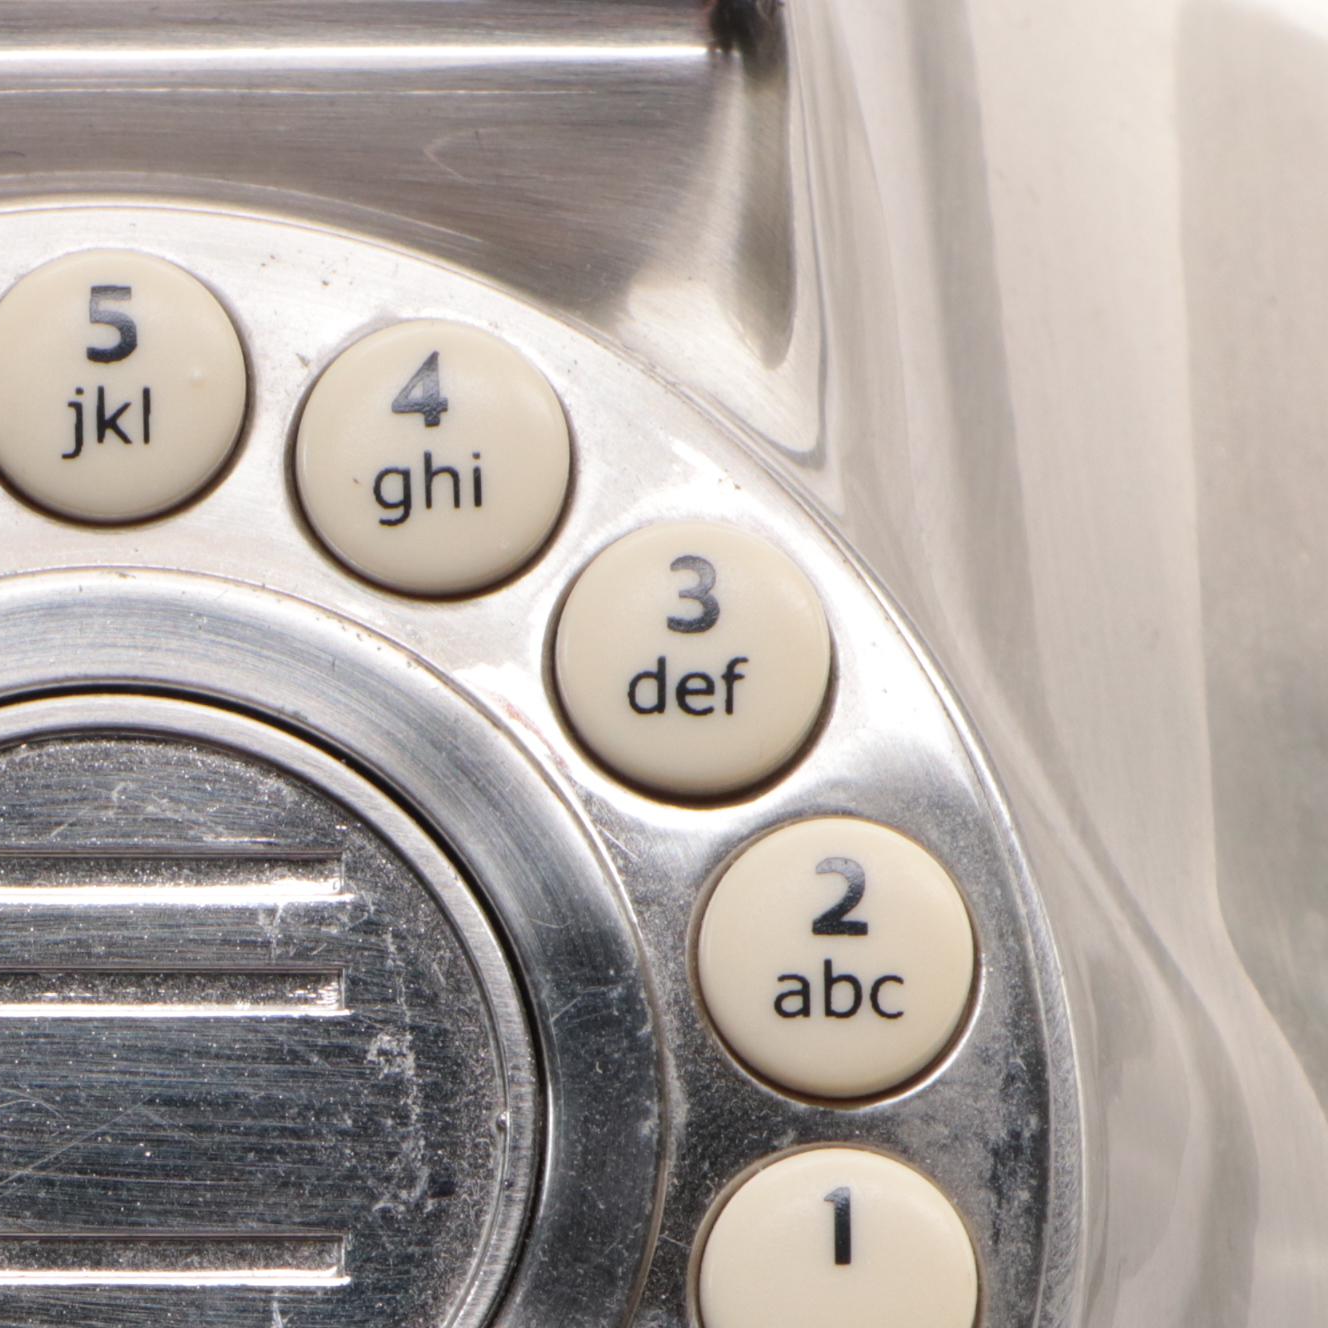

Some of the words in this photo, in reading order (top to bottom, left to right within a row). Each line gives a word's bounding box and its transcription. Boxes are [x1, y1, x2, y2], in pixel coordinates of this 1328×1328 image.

[85, 283, 138, 365] 5
[61, 385, 151, 460] jkl
[390, 350, 448, 428] 4
[373, 450, 482, 527] ghi
[666, 554, 720, 634] 3
[627, 655, 749, 717] def
[810, 856, 869, 937] 2
[773, 958, 904, 1020] abc
[823, 1186, 852, 1266] 1
